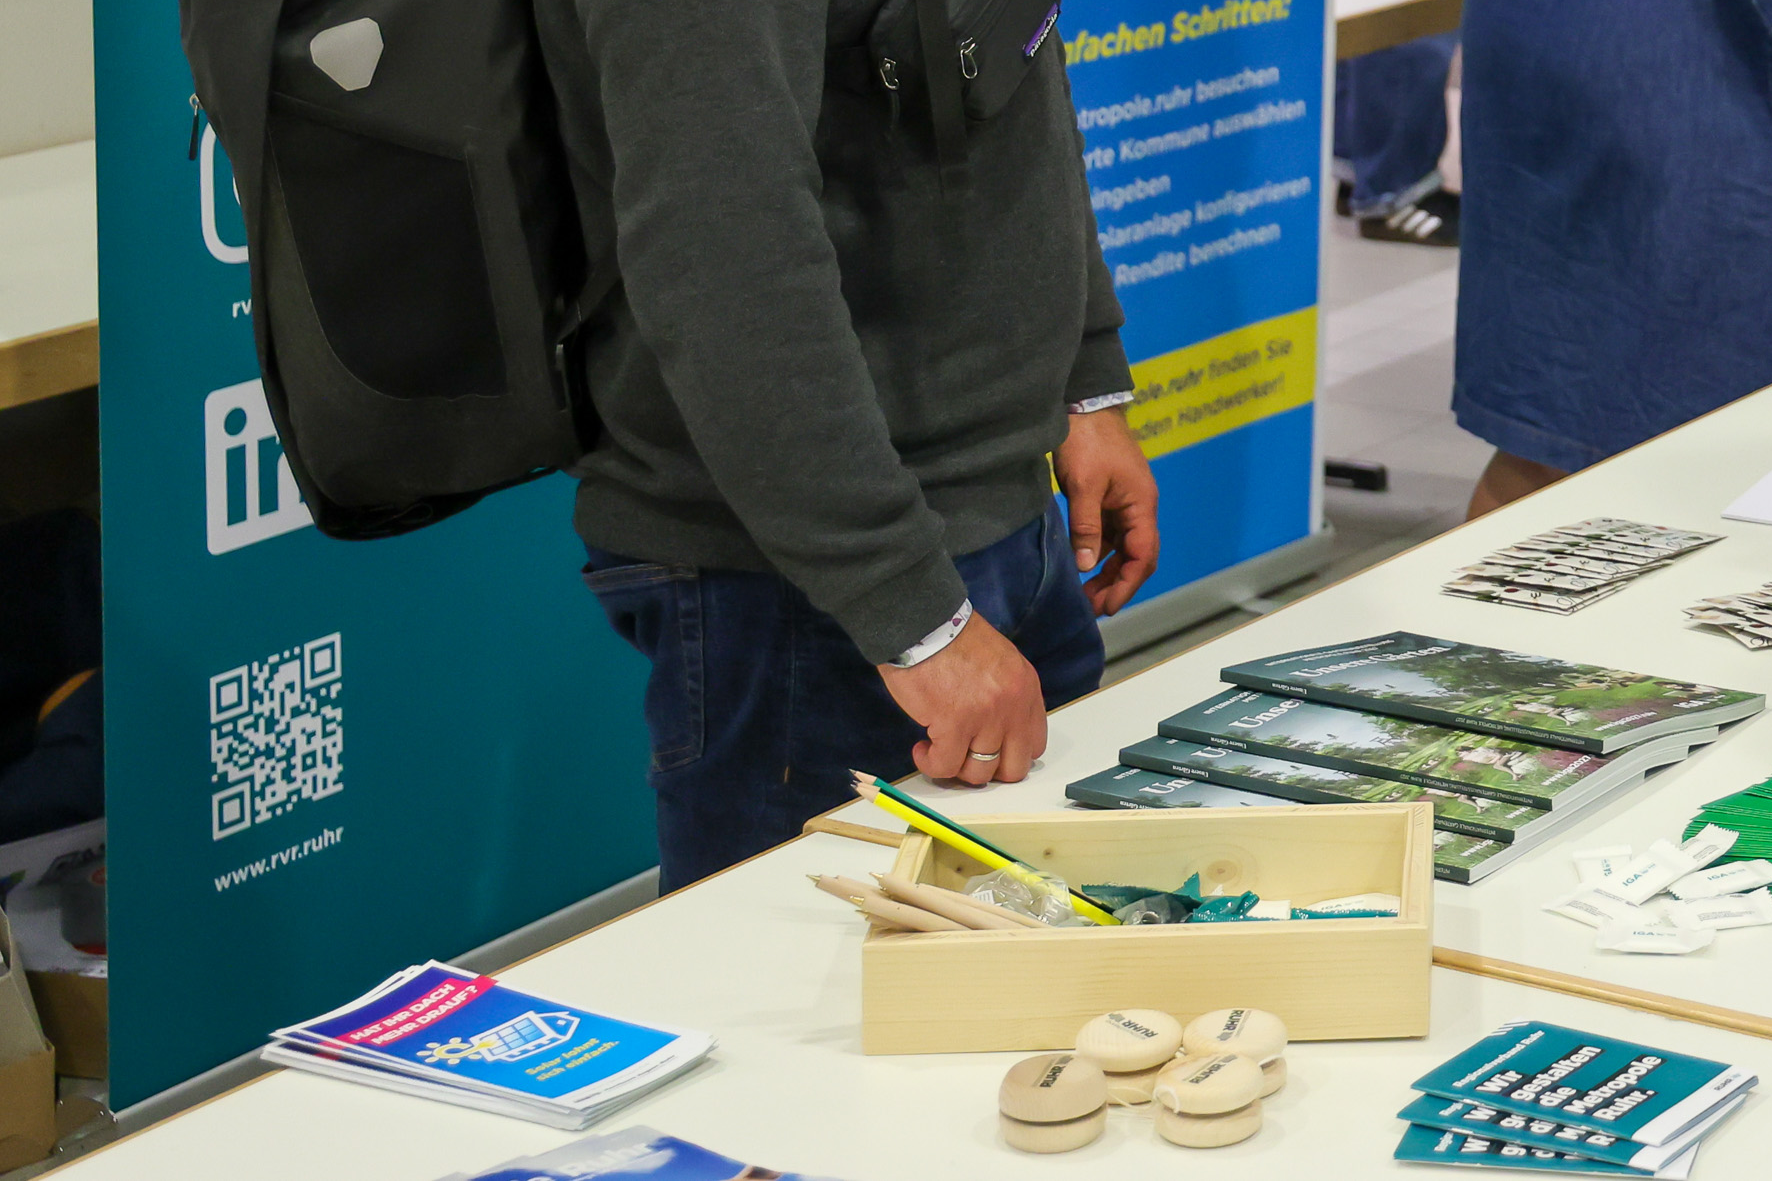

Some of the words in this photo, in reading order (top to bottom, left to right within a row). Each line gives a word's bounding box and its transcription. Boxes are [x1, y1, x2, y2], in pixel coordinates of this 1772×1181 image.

[1076, 84, 1194, 131] tropole.ruhr
[1194, 66, 1281, 104] besuchen
[1083, 146, 1117, 171] rte
[1118, 122, 1211, 163] Kommune
[1098, 209, 1193, 252] olaranlage
[1114, 250, 1187, 288] Rendite
[1189, 222, 1282, 267] berechnen
[232, 298, 252, 318] rv
[1132, 367, 1205, 408] ole.ruhr
[213, 823, 345, 894] www.rvr.ruhr
[1621, 873, 1642, 887] IGA
[1707, 872, 1729, 881] IGA
[350, 1020, 386, 1043] HAT
[383, 1007, 412, 1029] IHR
[409, 983, 456, 1014] DACH
[370, 1021, 418, 1046] MEHR
[413, 984, 480, 1027] DRAUF?
[1123, 1018, 1159, 1039] RUHR
[1222, 1009, 1245, 1032] RUHR
[524, 1054, 562, 1077] Solar
[560, 1037, 599, 1061] lohnt
[535, 1064, 567, 1083] sich
[564, 1039, 621, 1074] einfach.
[1452, 1041, 1521, 1089] Regionalverband
[1509, 1044, 1603, 1103] gestalten
[1474, 1069, 1524, 1096] Wir
[1538, 1085, 1578, 1109] die
[1561, 1054, 1663, 1116] Metropole
[1590, 1088, 1658, 1122] Ruhr.
